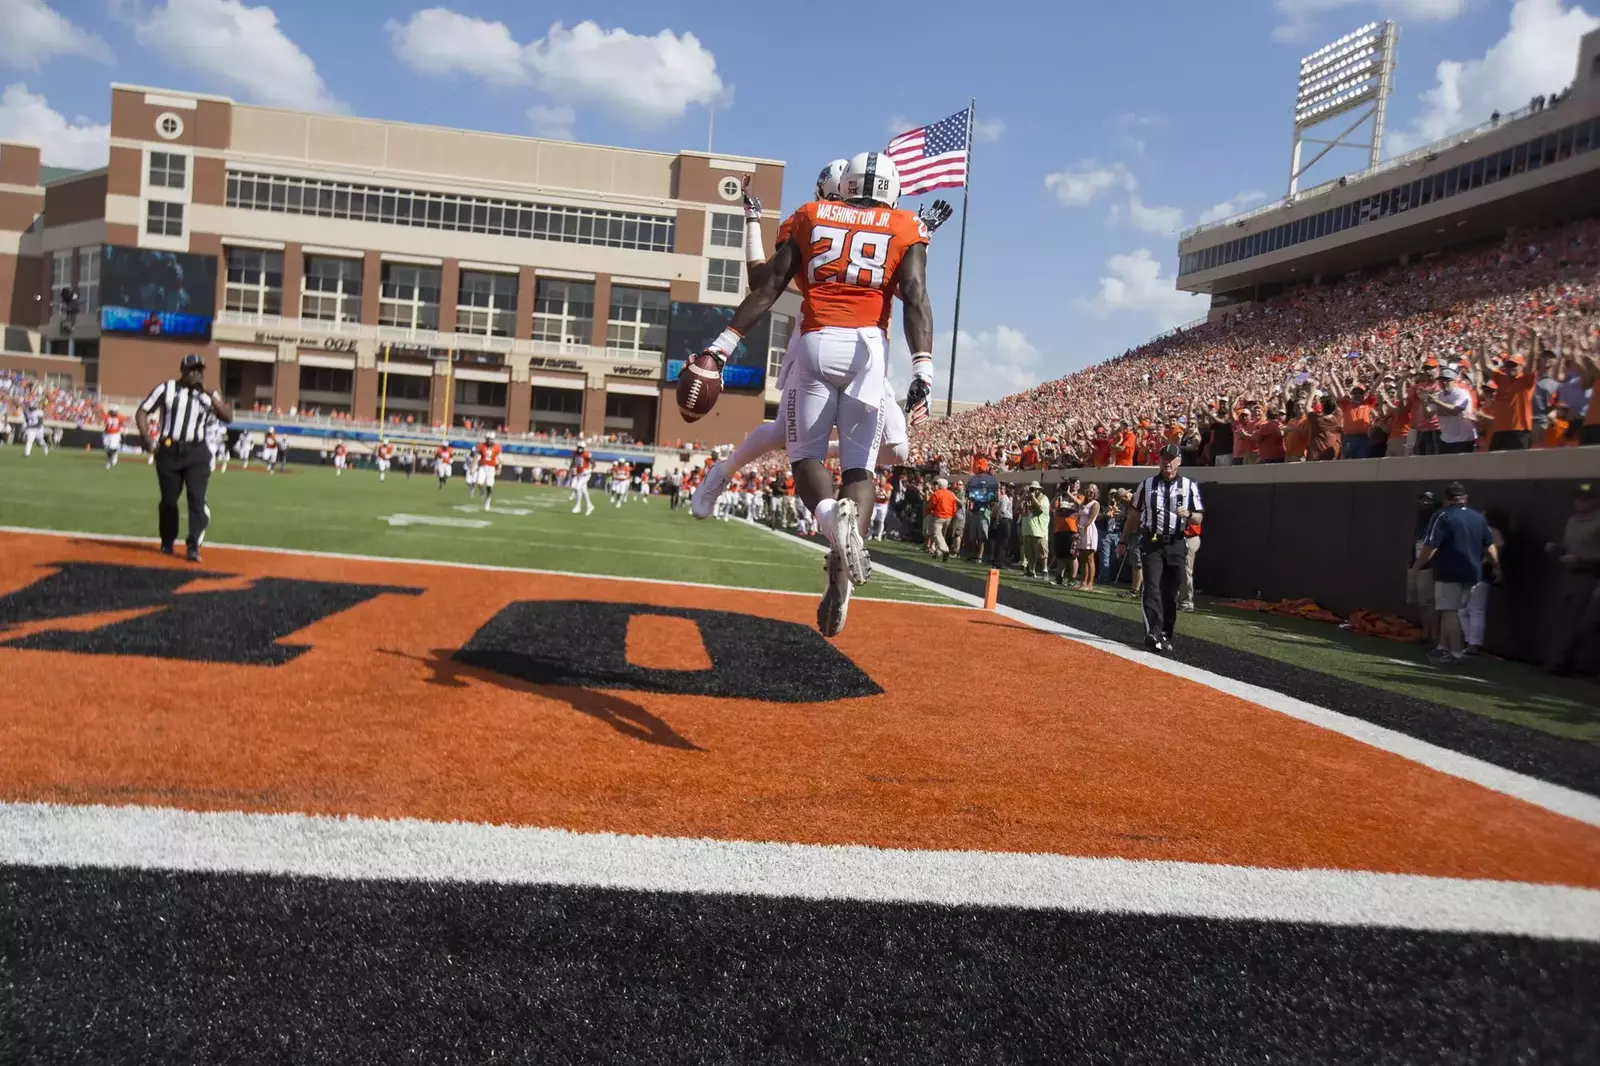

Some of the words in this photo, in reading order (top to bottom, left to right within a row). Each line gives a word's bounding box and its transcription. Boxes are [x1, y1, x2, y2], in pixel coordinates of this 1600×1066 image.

[878, 179, 889, 191] 28
[816, 203, 875, 225] WASHINGTON
[808, 224, 895, 290] 28
[613, 365, 651, 377] verizon
[787, 389, 797, 443] COWBOYS
